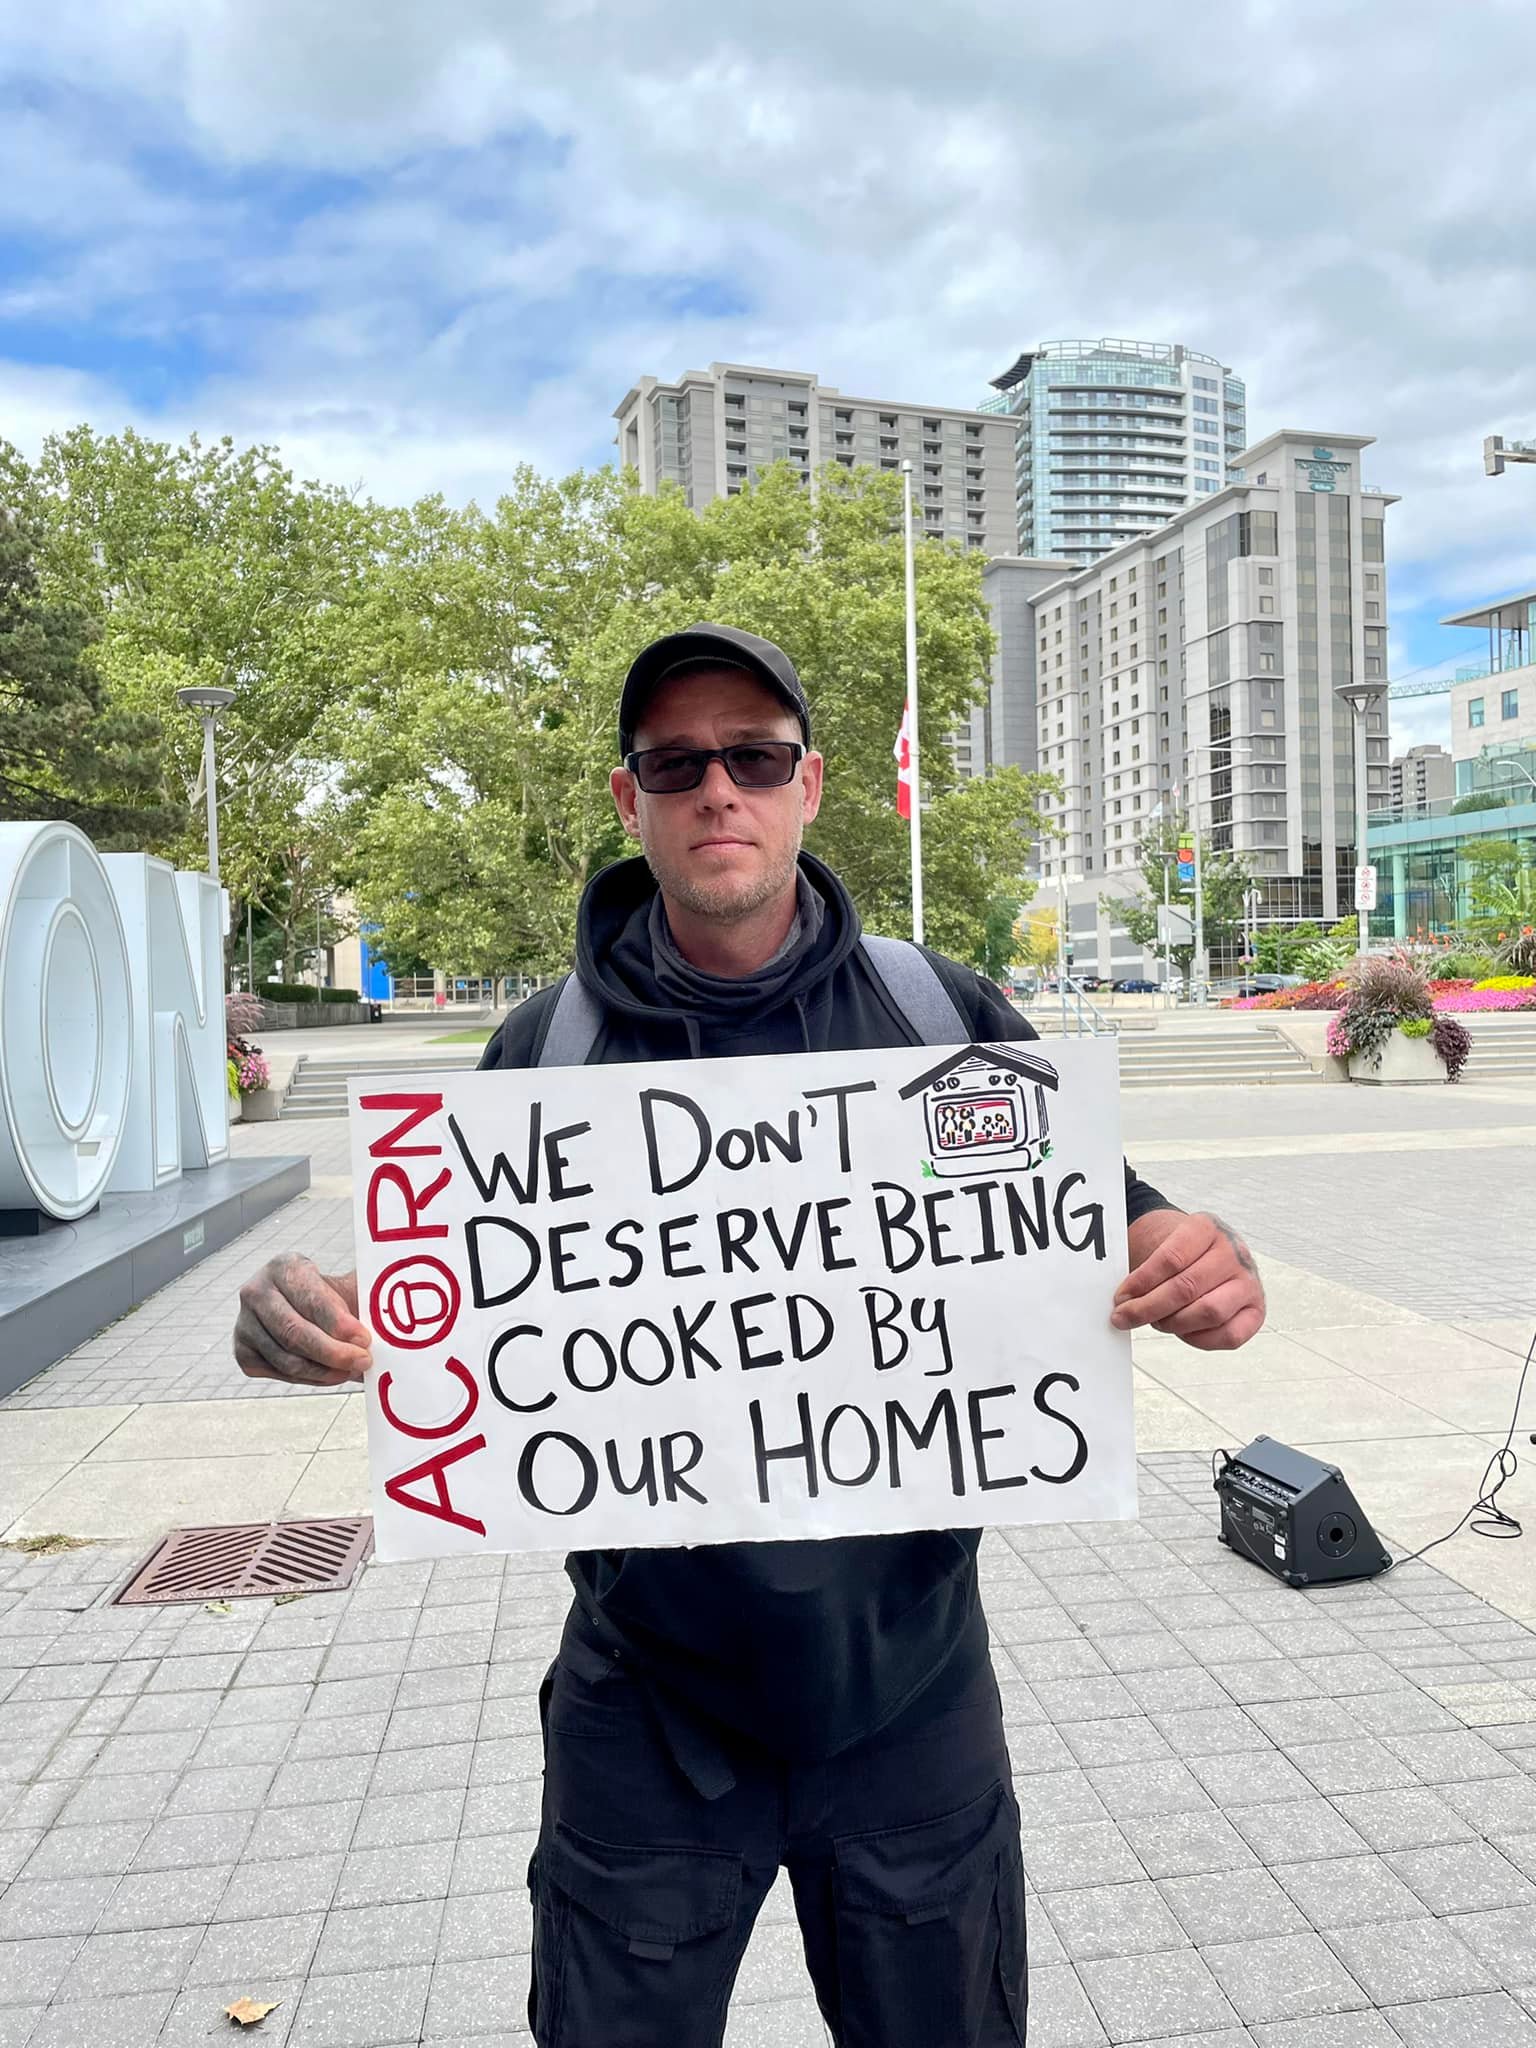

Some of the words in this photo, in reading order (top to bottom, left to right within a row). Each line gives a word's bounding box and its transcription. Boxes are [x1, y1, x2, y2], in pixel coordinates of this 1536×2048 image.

[447, 1101, 594, 1205] WE
[464, 1197, 857, 1309] DESERVE
[871, 1172, 1107, 1274] BEING
[360, 1093, 486, 1536] ACORN
[487, 1292, 835, 1413] COOKED
[517, 1430, 708, 1517] OUR
[749, 1372, 1088, 1503] HOMES
